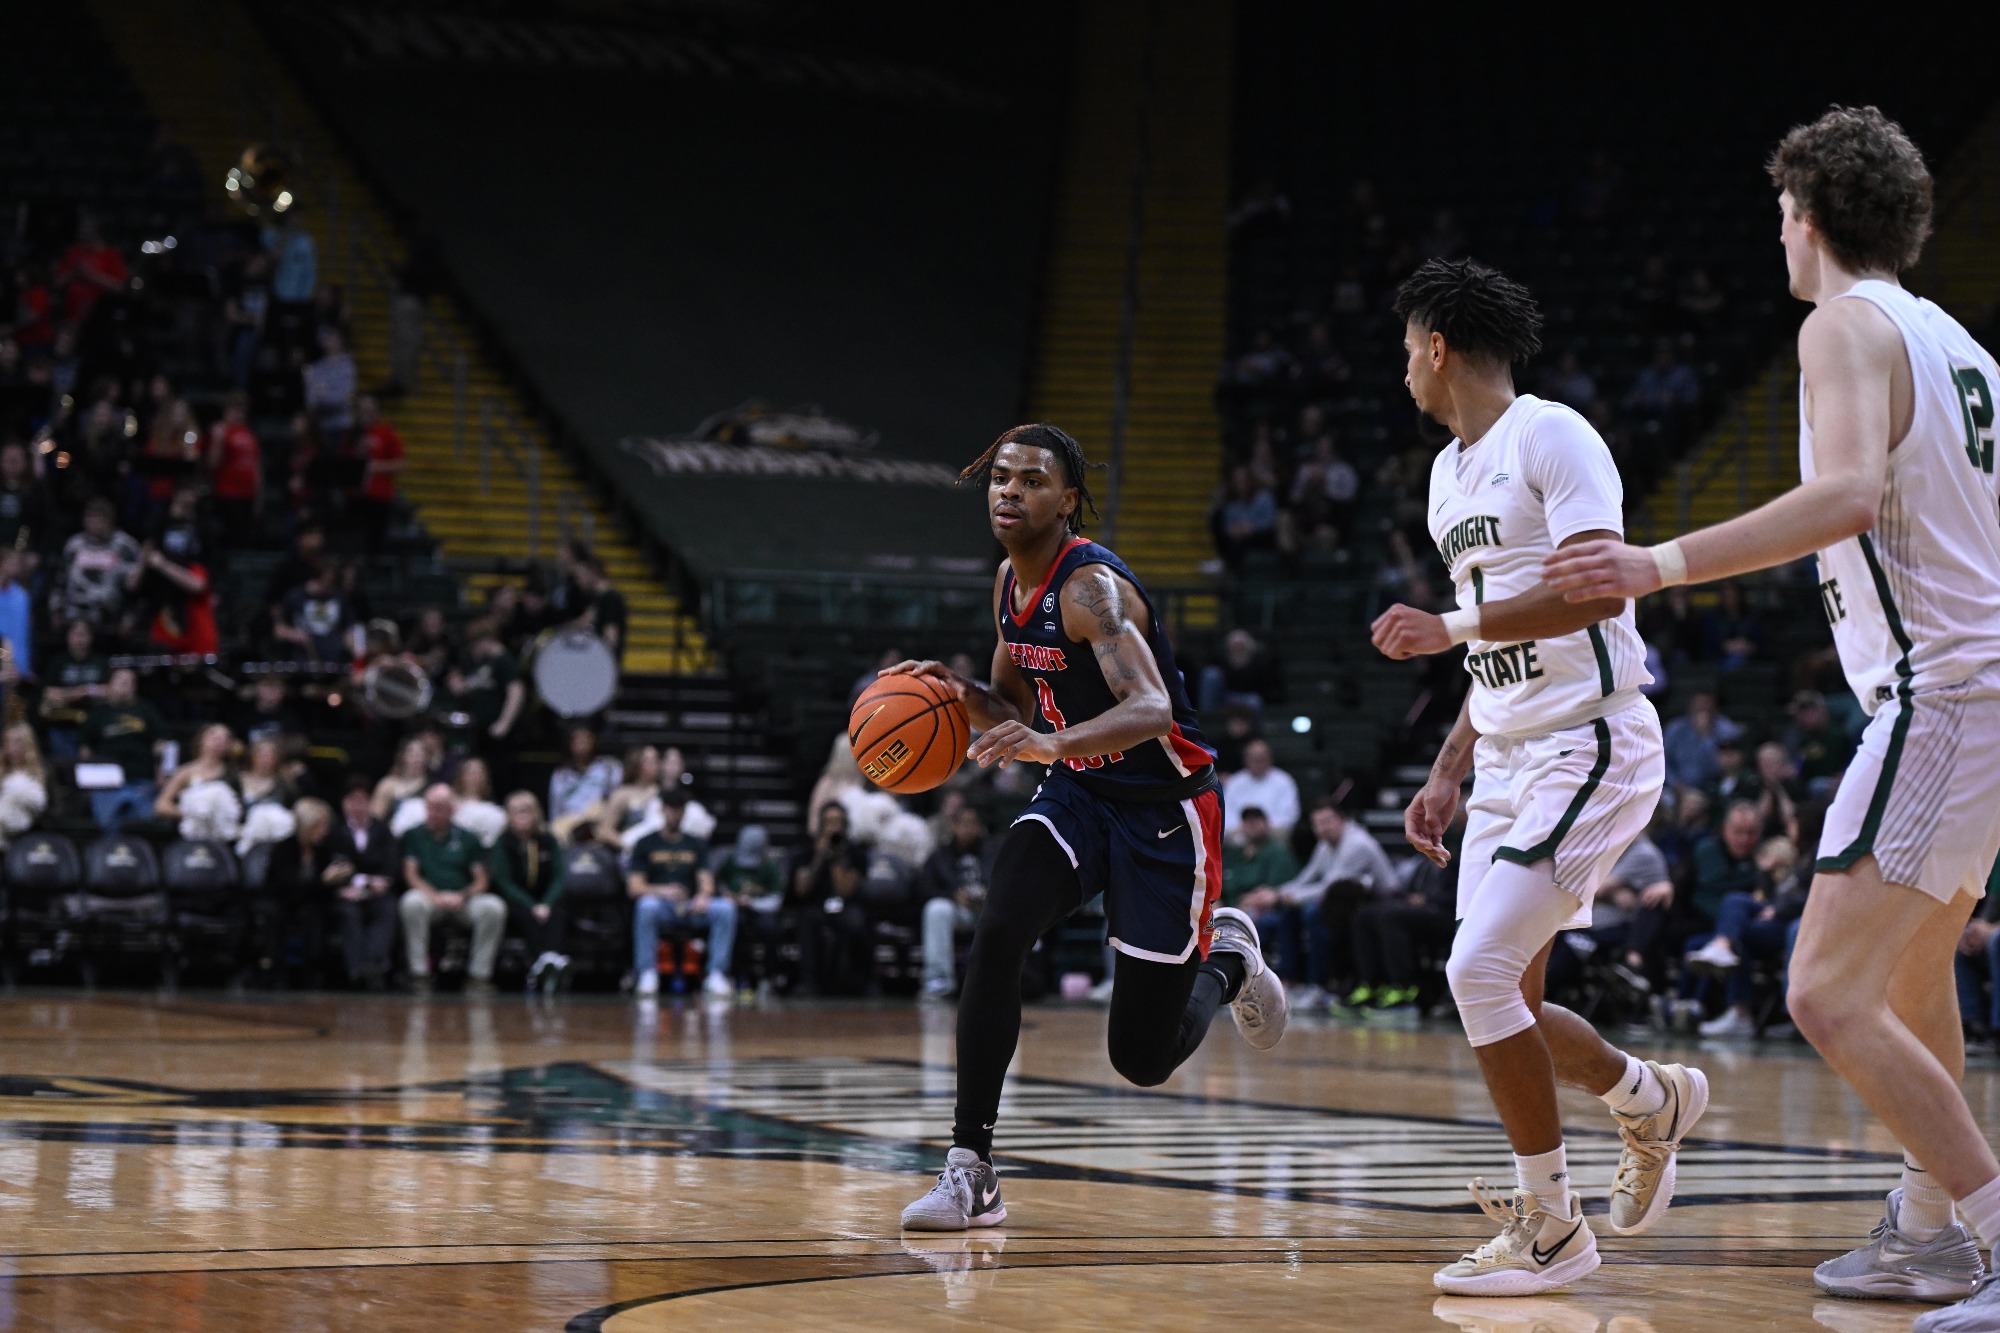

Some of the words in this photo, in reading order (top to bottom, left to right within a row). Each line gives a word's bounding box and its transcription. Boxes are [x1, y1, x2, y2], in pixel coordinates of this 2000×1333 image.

[1948, 360, 1995, 475] 12
[1440, 515, 1503, 570] WRIGHT
[1470, 565, 1484, 605] 1
[1004, 642, 1068, 671] ETROIT
[1467, 640, 1544, 688] STATE
[1034, 678, 1067, 732] 4
[863, 738, 910, 780] ELITE
